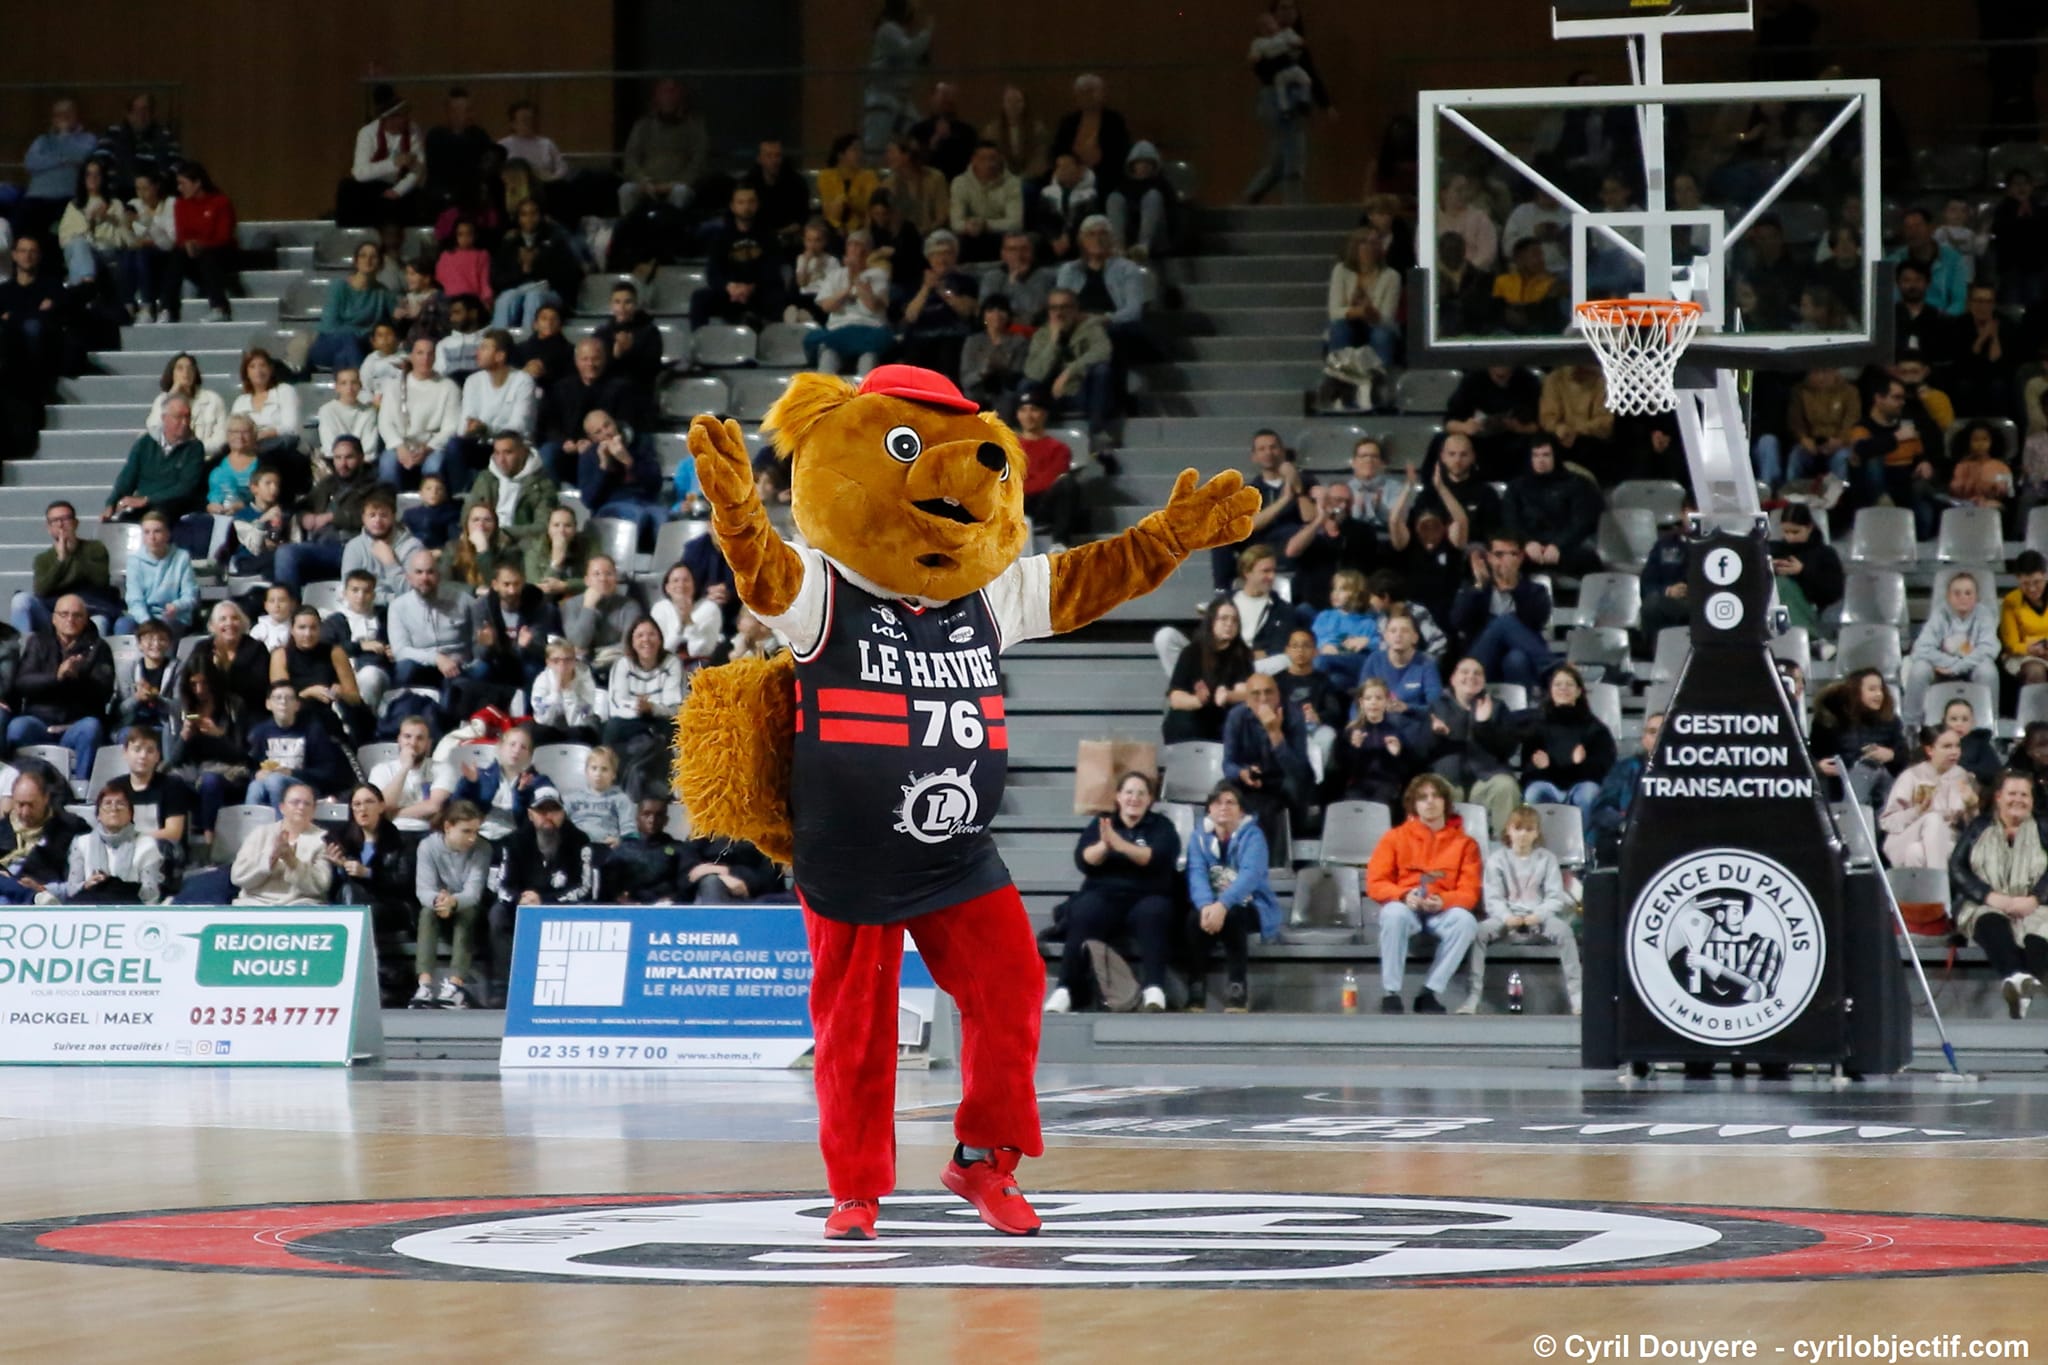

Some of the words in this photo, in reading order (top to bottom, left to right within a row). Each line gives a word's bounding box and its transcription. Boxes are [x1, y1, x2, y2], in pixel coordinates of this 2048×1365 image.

[858, 639, 903, 685] LE
[905, 645, 998, 688] HAVRE
[913, 700, 984, 749] 76
[1674, 714, 1779, 734] GESTION
[1665, 746, 1788, 766] LOCATION
[1642, 776, 1813, 797] TRANSACTION
[1642, 866, 1711, 949] AGENCE
[1718, 864, 1751, 883] DU
[1756, 874, 1810, 951] PALAIS
[214, 934, 333, 950] REJOIGNEZ
[649, 933, 671, 945] LA
[676, 933, 739, 945] SHEMA
[647, 951, 768, 962] ACCOMPAGNE
[775, 951, 813, 962] VOT
[232, 960, 297, 976] NOUS
[645, 967, 776, 979] IMPLANTATION
[643, 985, 664, 996] LE
[670, 985, 729, 997] HAVRE
[735, 985, 811, 997] METROP
[10, 1012, 90, 1024] PACKGEL
[104, 1012, 153, 1024] MAEX
[190, 1007, 215, 1025] 02
[220, 1007, 246, 1025] 35
[252, 1007, 277, 1025] 24
[283, 1007, 309, 1025] 77
[314, 1007, 340, 1025] 77
[1668, 998, 1787, 1031] IMMOBILIER
[53, 1042, 85, 1050] Suivez
[528, 1046, 551, 1058] 02
[557, 1046, 580, 1058] 35
[587, 1046, 609, 1058] 19
[616, 1046, 638, 1058] 77
[644, 1046, 668, 1059] 00
[677, 1052, 761, 1060] www.shema.fr
